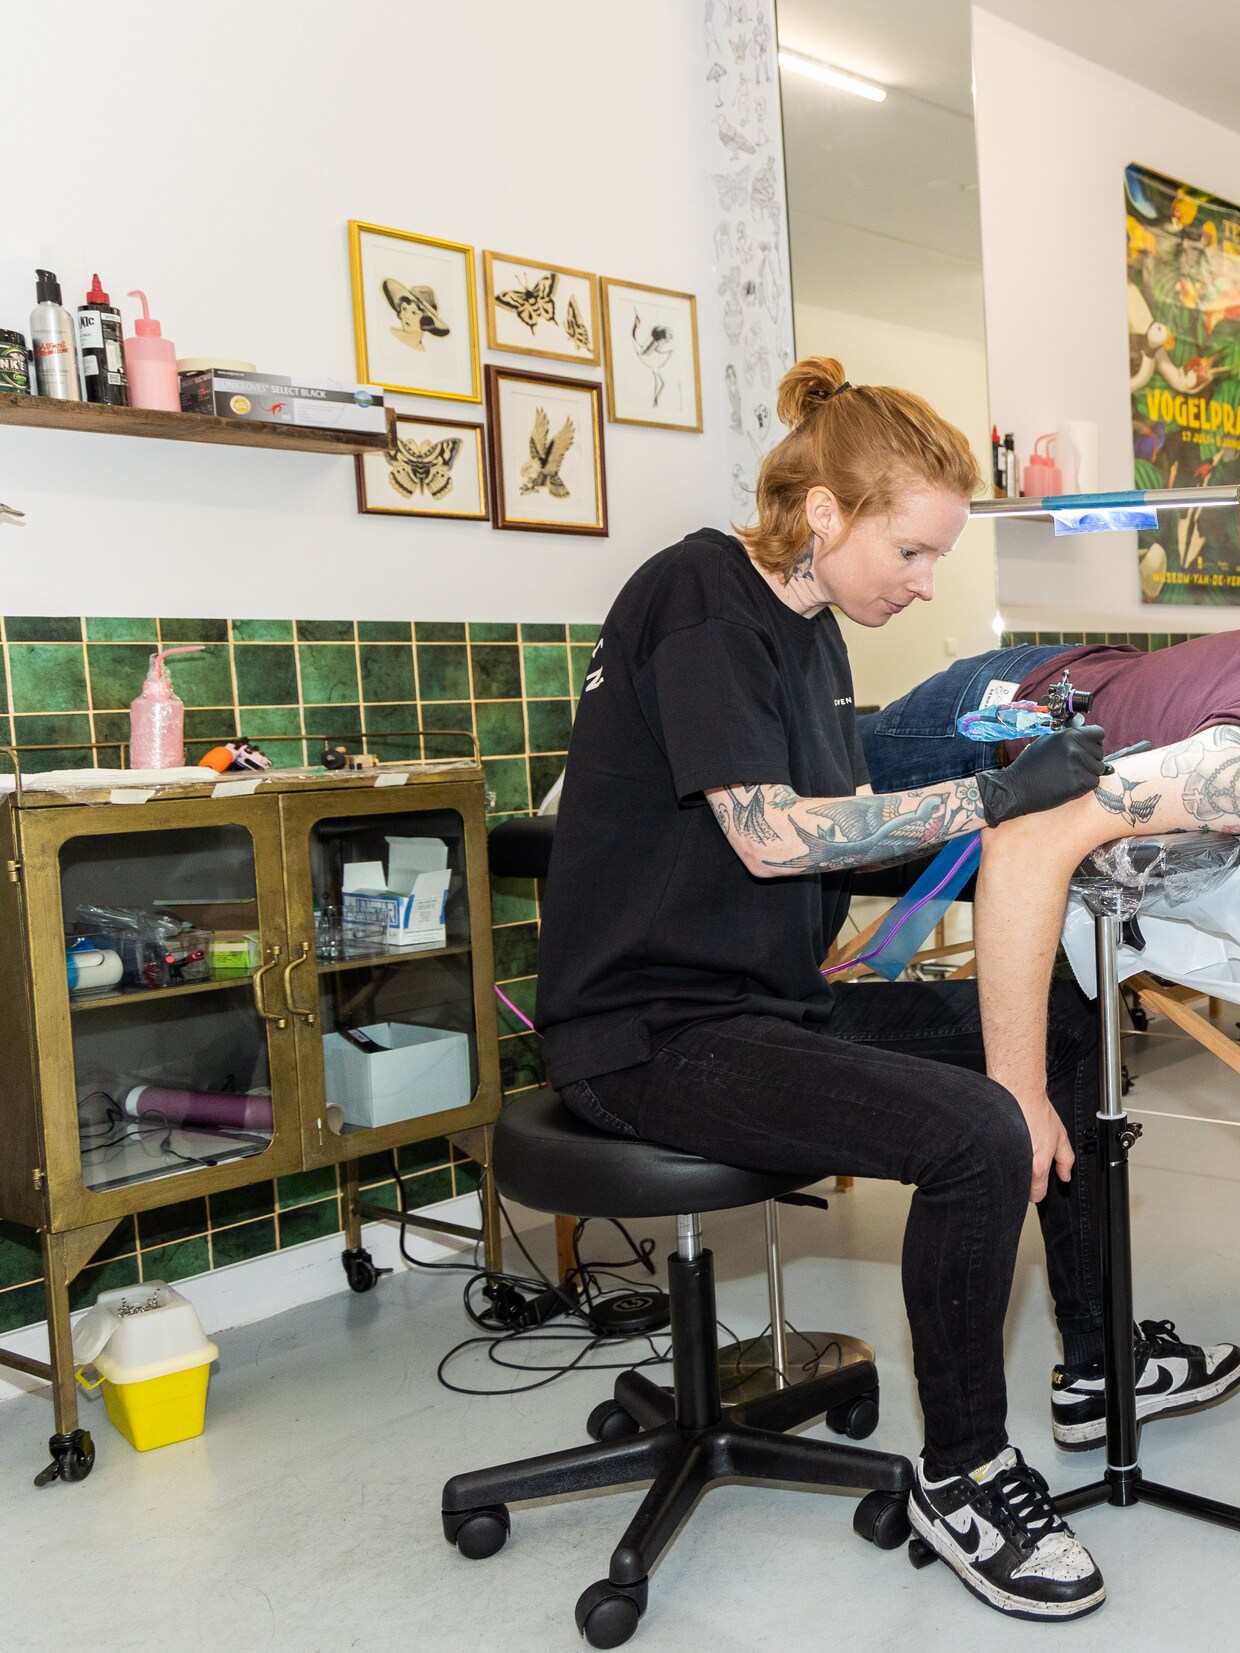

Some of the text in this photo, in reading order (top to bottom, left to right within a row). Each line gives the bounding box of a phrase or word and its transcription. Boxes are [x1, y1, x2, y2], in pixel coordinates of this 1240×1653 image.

[271, 385, 299, 397] SELECT
[301, 388, 327, 399] BLACK
[1152, 572, 1190, 584] MUSEUM
